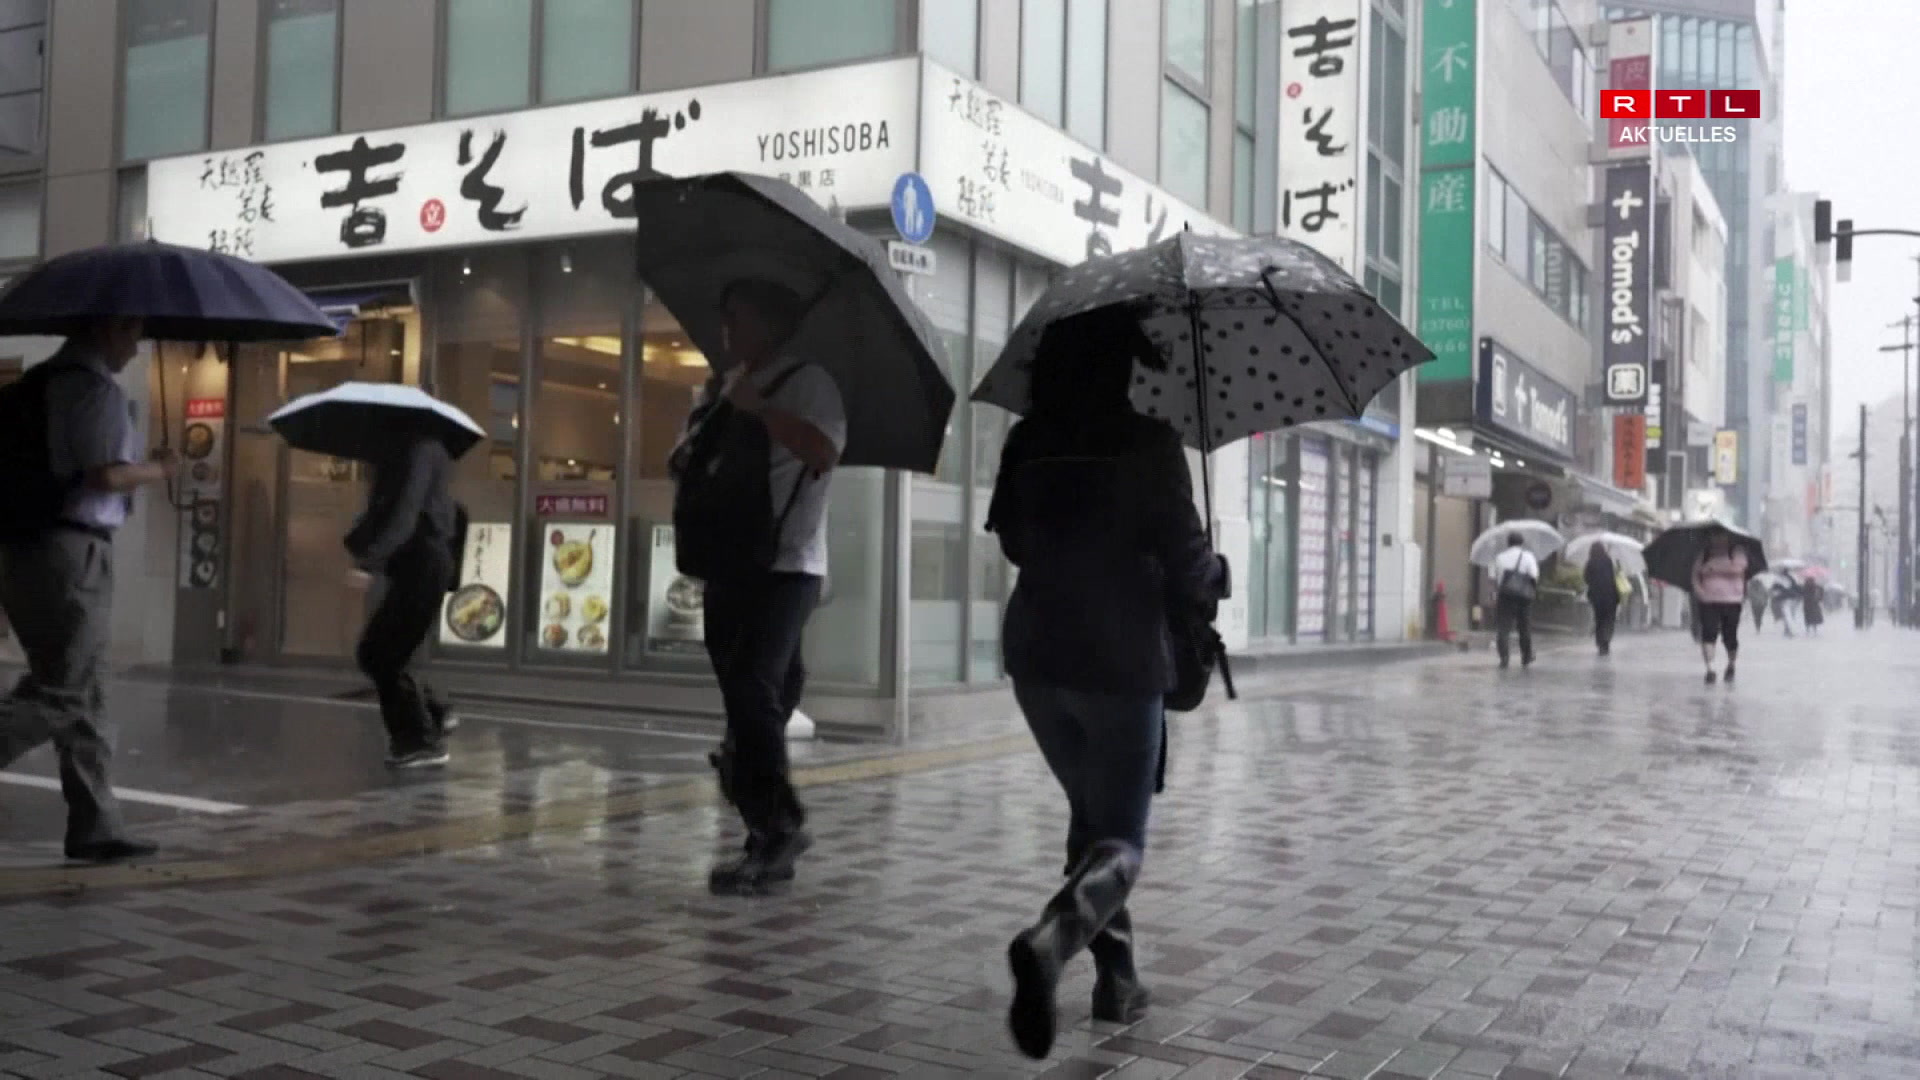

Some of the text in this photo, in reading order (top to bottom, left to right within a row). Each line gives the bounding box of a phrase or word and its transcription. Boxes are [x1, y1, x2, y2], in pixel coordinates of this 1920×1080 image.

[315, 98, 702, 248] 吉そば
[757, 119, 890, 163] YOSHISOBA
[1283, 16, 1357, 233] 吉そば
[1425, 0, 1468, 214] 不動産
[1611, 231, 1644, 345] Tomod's
